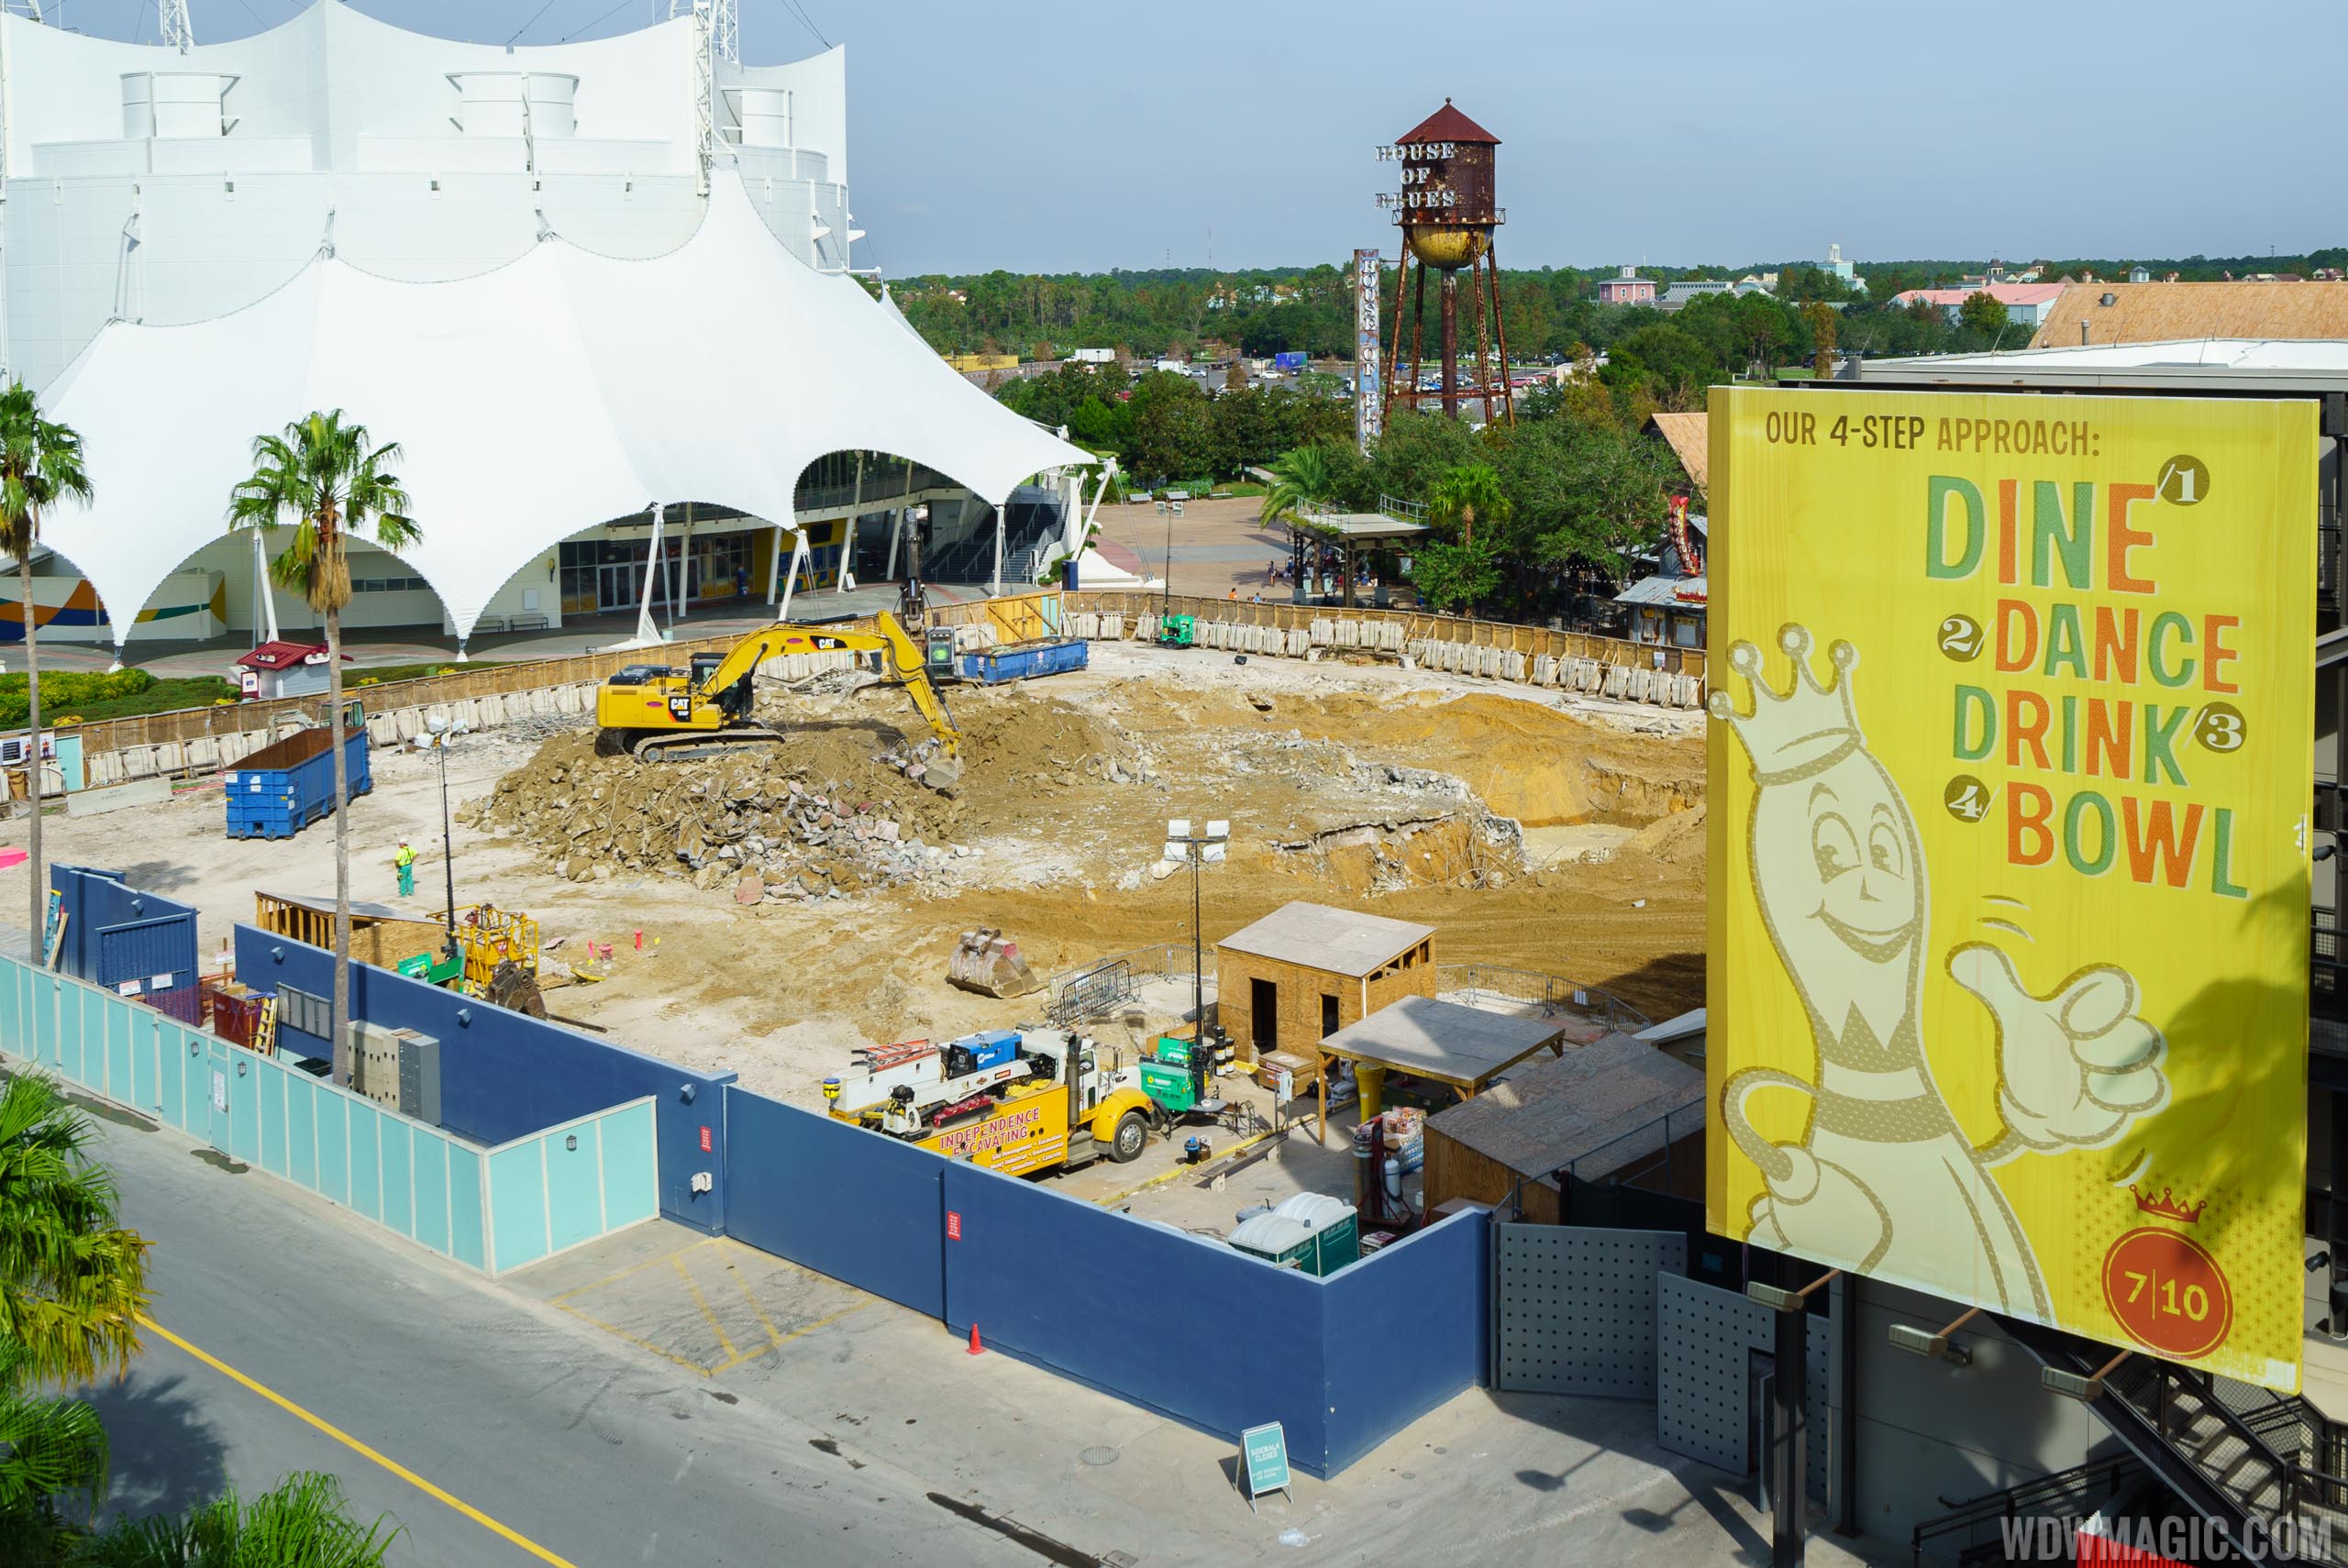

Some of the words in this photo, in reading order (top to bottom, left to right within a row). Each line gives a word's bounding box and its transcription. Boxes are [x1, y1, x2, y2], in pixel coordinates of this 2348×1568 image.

[1375, 142, 1456, 161] HOUSE
[1400, 167, 1431, 184] OF
[1375, 190, 1456, 209] BLUES
[1362, 259, 1378, 331] HOUSE
[1363, 348, 1378, 377] OF
[1364, 392, 1378, 457] BLU
[1766, 411, 1817, 446] OUR
[1830, 414, 1925, 450] 4-STEP
[1937, 417, 2101, 457] APPROACH:
[1926, 474, 2159, 596] DINE
[818, 638, 836, 649] CAT
[1995, 598, 2243, 696] DANCE
[670, 698, 690, 711] CAT
[1953, 683, 2195, 789] DRINK
[2006, 779, 2252, 900] BOWL
[939, 1108, 1040, 1150] INDEPENDENCE
[1255, 1451, 1279, 1463] CLOSED
